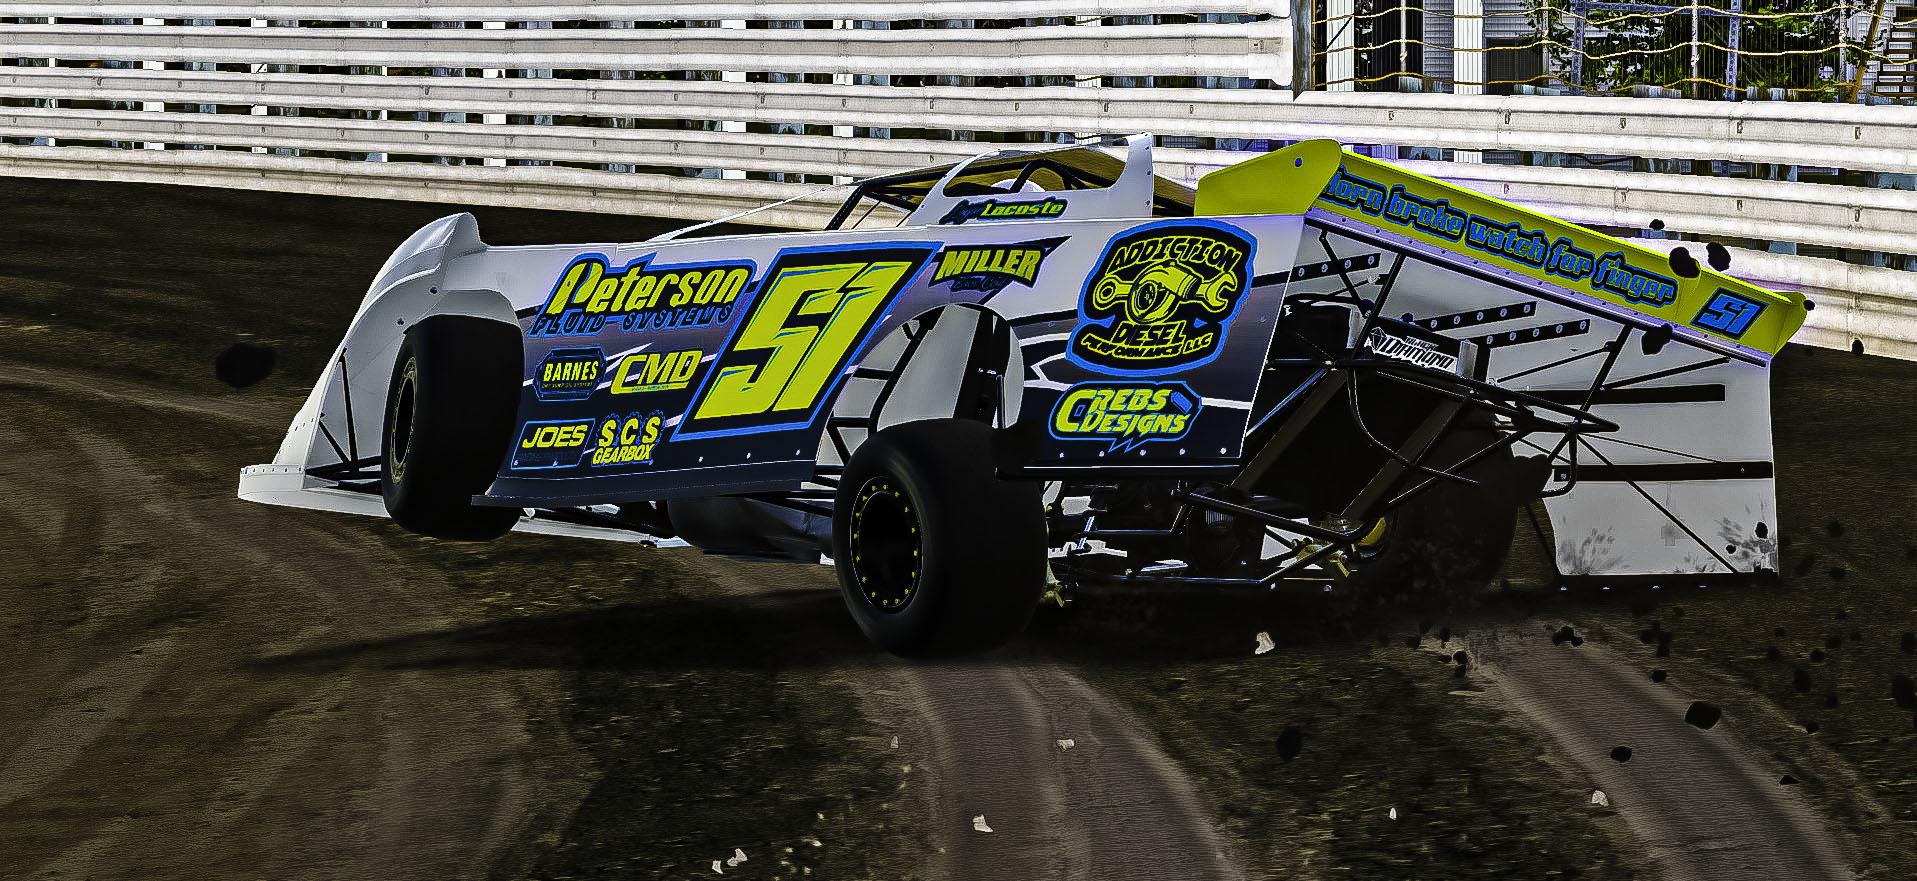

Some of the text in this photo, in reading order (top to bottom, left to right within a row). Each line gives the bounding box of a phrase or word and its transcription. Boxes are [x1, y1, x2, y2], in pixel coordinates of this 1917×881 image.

[980, 201, 1064, 217] Lacoste
[1104, 235, 1242, 276] ADDICTION
[1387, 192, 1465, 235] broke
[1469, 220, 1546, 262] watch
[1550, 244, 1591, 275] for
[1593, 257, 1675, 302] finger
[934, 250, 1042, 281] MILLER
[546, 261, 749, 314] Peterson
[529, 303, 733, 336] FLUID SYSTEMS
[1698, 293, 1760, 334] 51
[694, 261, 913, 420] 51
[1111, 320, 1188, 347] DIESEL
[543, 361, 599, 382] BARNES
[610, 350, 703, 394] CMD
[1056, 389, 1173, 433] CREBS
[1080, 411, 1191, 438] DESIGNS
[522, 424, 589, 448] JOES
[592, 444, 656, 465] GEARBOX
